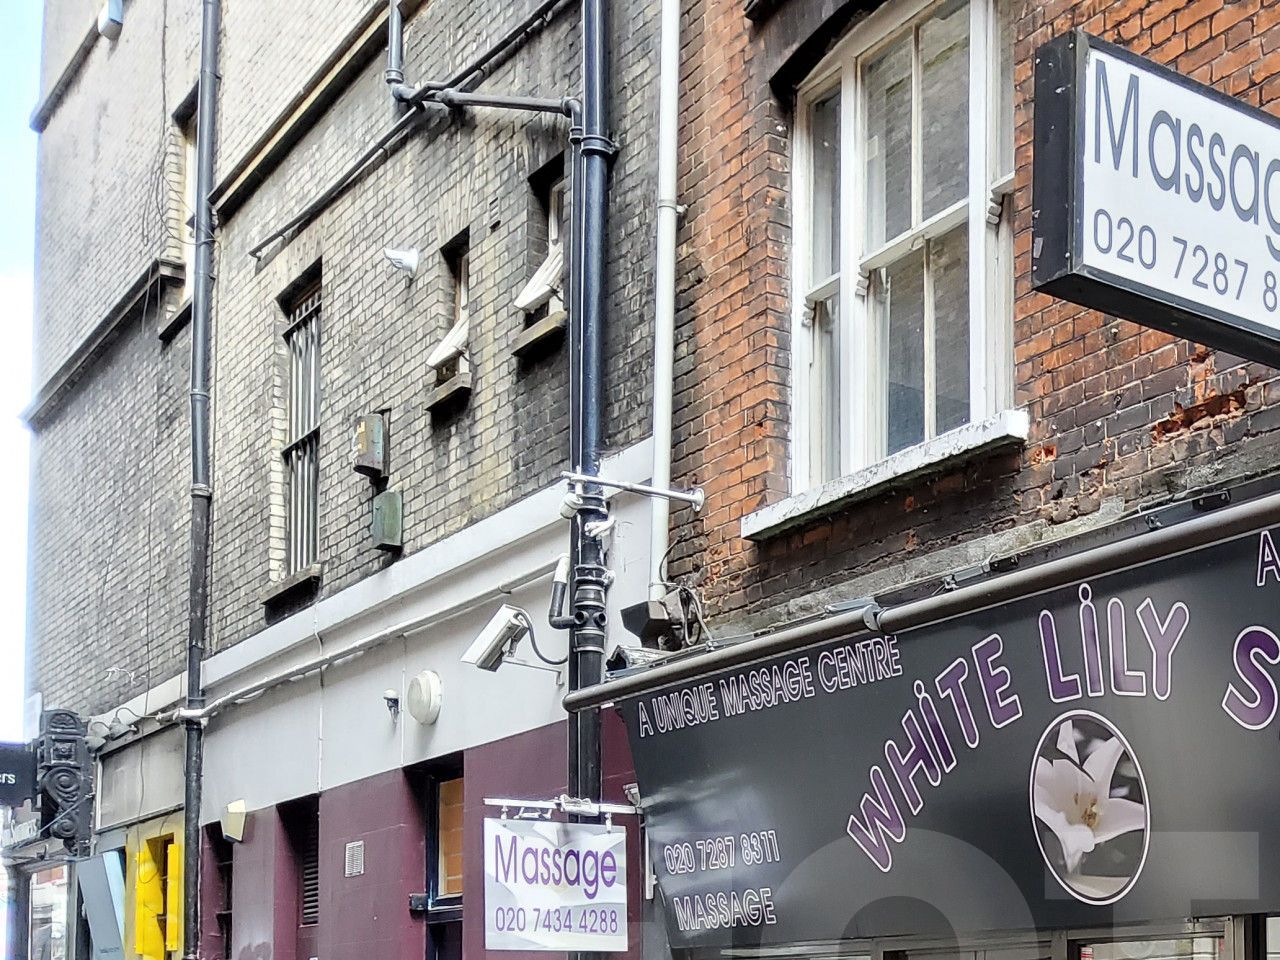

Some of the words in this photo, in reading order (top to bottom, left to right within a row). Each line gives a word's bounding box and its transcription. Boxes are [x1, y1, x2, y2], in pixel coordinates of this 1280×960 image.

[1093, 208, 1158, 270] 020
[1172, 236, 1249, 301] 7287
[638, 701, 654, 738] A
[651, 683, 720, 734] UNIQUE
[719, 657, 816, 717] MASSAGE
[817, 635, 903, 693] CENTRE
[494, 834, 618, 900] Massage
[663, 843, 696, 875] 020
[695, 836, 735, 871] 7287
[740, 830, 780, 866] 8311
[495, 906, 526, 932] 020
[533, 908, 573, 933] 7434
[578, 909, 618, 934] 4288
[673, 887, 777, 931] MASSAGE
